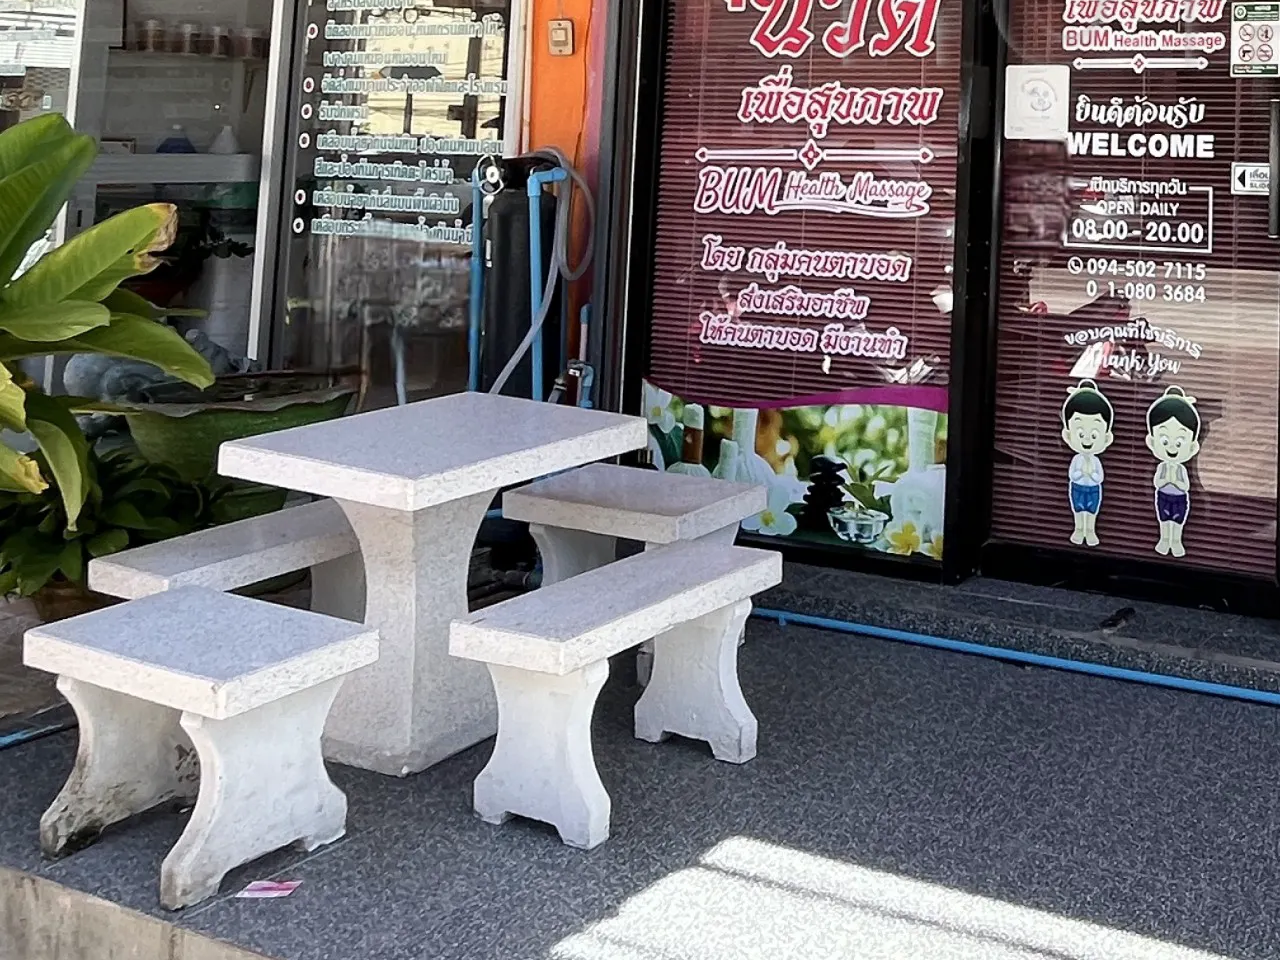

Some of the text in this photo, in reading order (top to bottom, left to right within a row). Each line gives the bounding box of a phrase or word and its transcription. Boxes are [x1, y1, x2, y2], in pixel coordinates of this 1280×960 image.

[1063, 27, 1225, 53] BUM Health Massage
[738, 64, 943, 138] เพื่อสุขภาพ
[1075, 95, 1205, 128] ยินดีต้อนรับ
[1067, 131, 1215, 159] WELCOME
[695, 167, 931, 214] BUM Health Massage
[1098, 199, 1180, 216] OPEN DAILY
[1072, 218, 1128, 240] 08.00
[1145, 221, 1204, 243] 20.00
[701, 235, 912, 282] โดย กลุ่มคนตาบอด
[1087, 258, 1206, 280] 094-502 7115
[738, 284, 870, 319] ส่งเสริมอาชีพ
[1163, 285, 1206, 303] 3684
[700, 314, 907, 357] ให้คนตาบอด มีงานทำ
[1064, 320, 1203, 359] ขอบคุณที่ใช้บริการ
[1148, 351, 1181, 376] You
